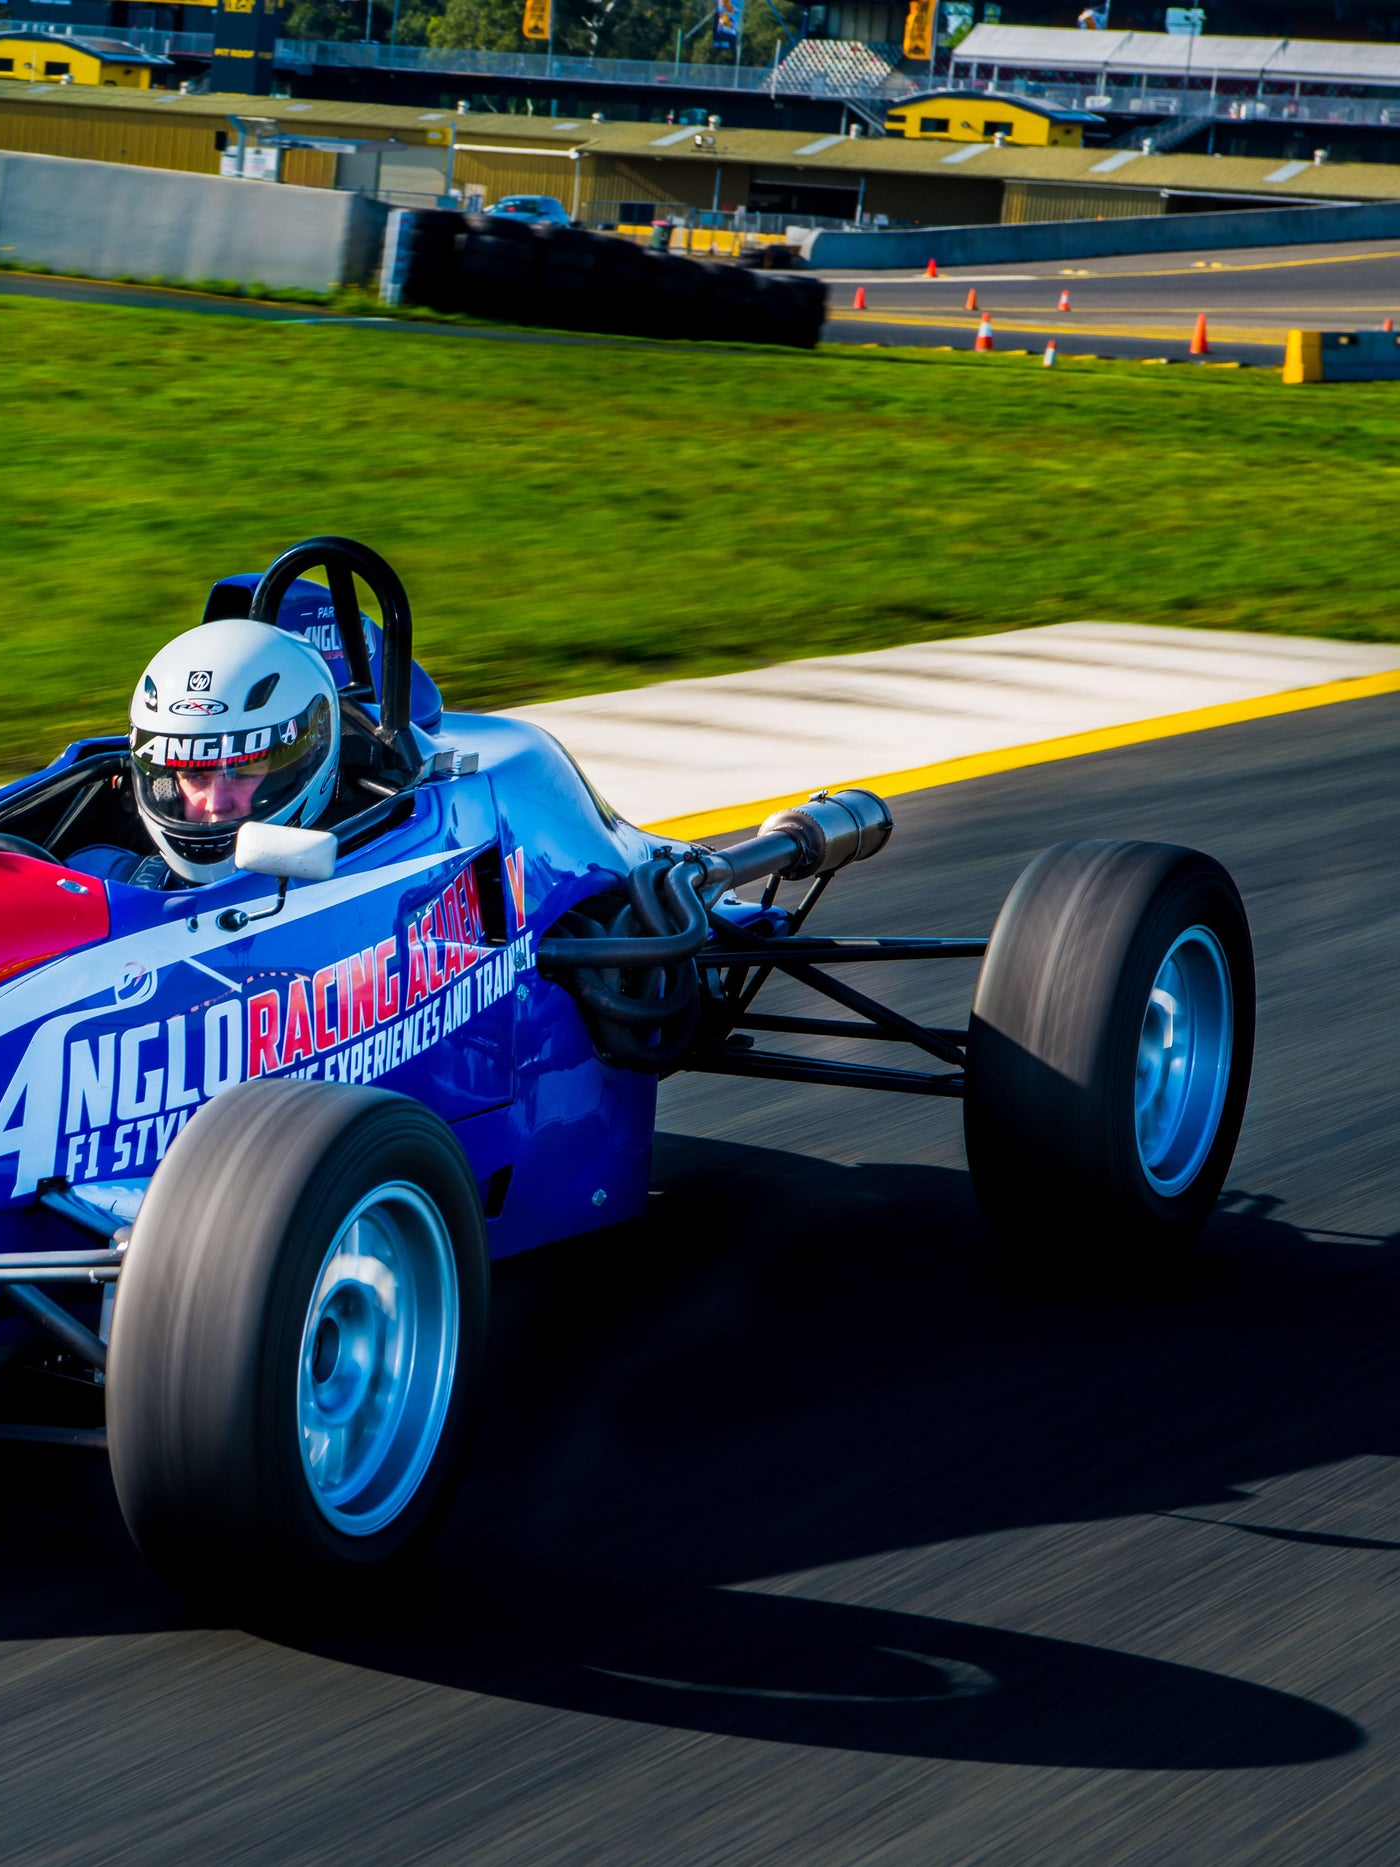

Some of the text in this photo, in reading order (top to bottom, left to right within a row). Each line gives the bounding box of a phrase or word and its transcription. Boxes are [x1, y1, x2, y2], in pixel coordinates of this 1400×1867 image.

[317, 606, 335, 619] PAR
[135, 728, 272, 766] ANGLO
[247, 935, 401, 1078] RACING
[66, 1131, 100, 1183] F1
[324, 997, 441, 1085] EXPERIENCES
[442, 976, 472, 1038] AND
